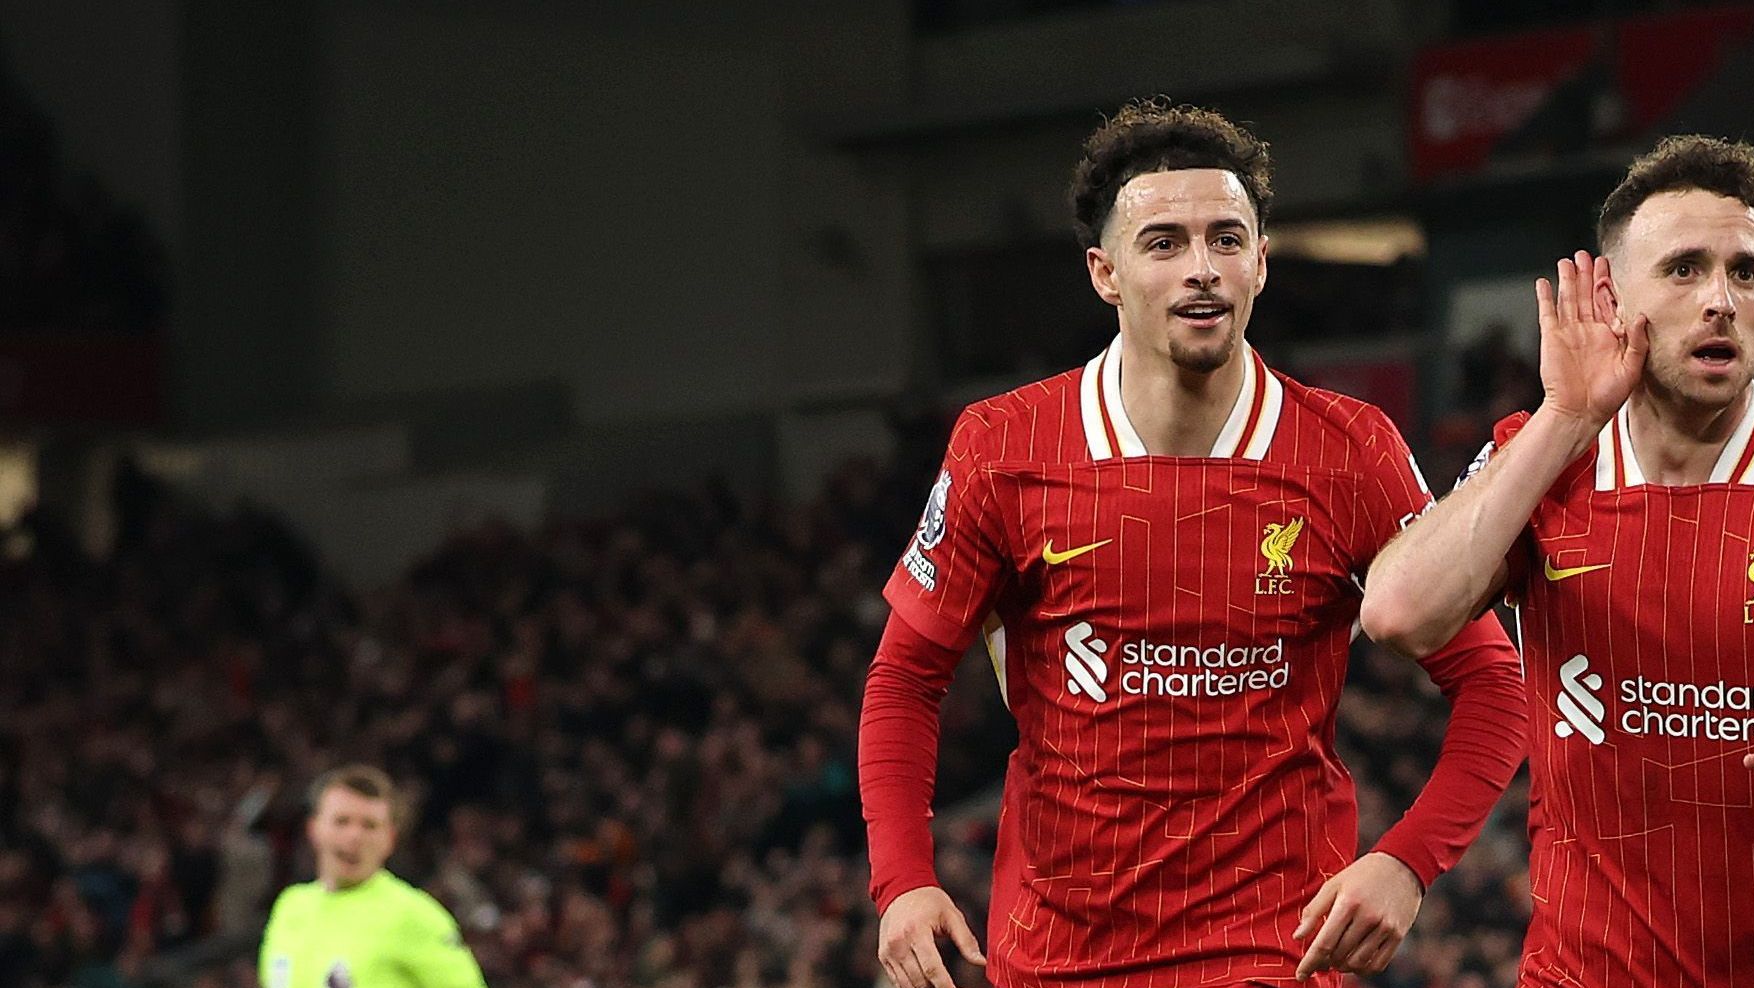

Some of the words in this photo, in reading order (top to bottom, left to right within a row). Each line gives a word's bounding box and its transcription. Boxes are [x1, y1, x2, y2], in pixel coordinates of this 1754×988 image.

[1254, 579, 1295, 595] L.F.C.
[1122, 639, 1284, 669] standard
[1122, 662, 1289, 697] chartered
